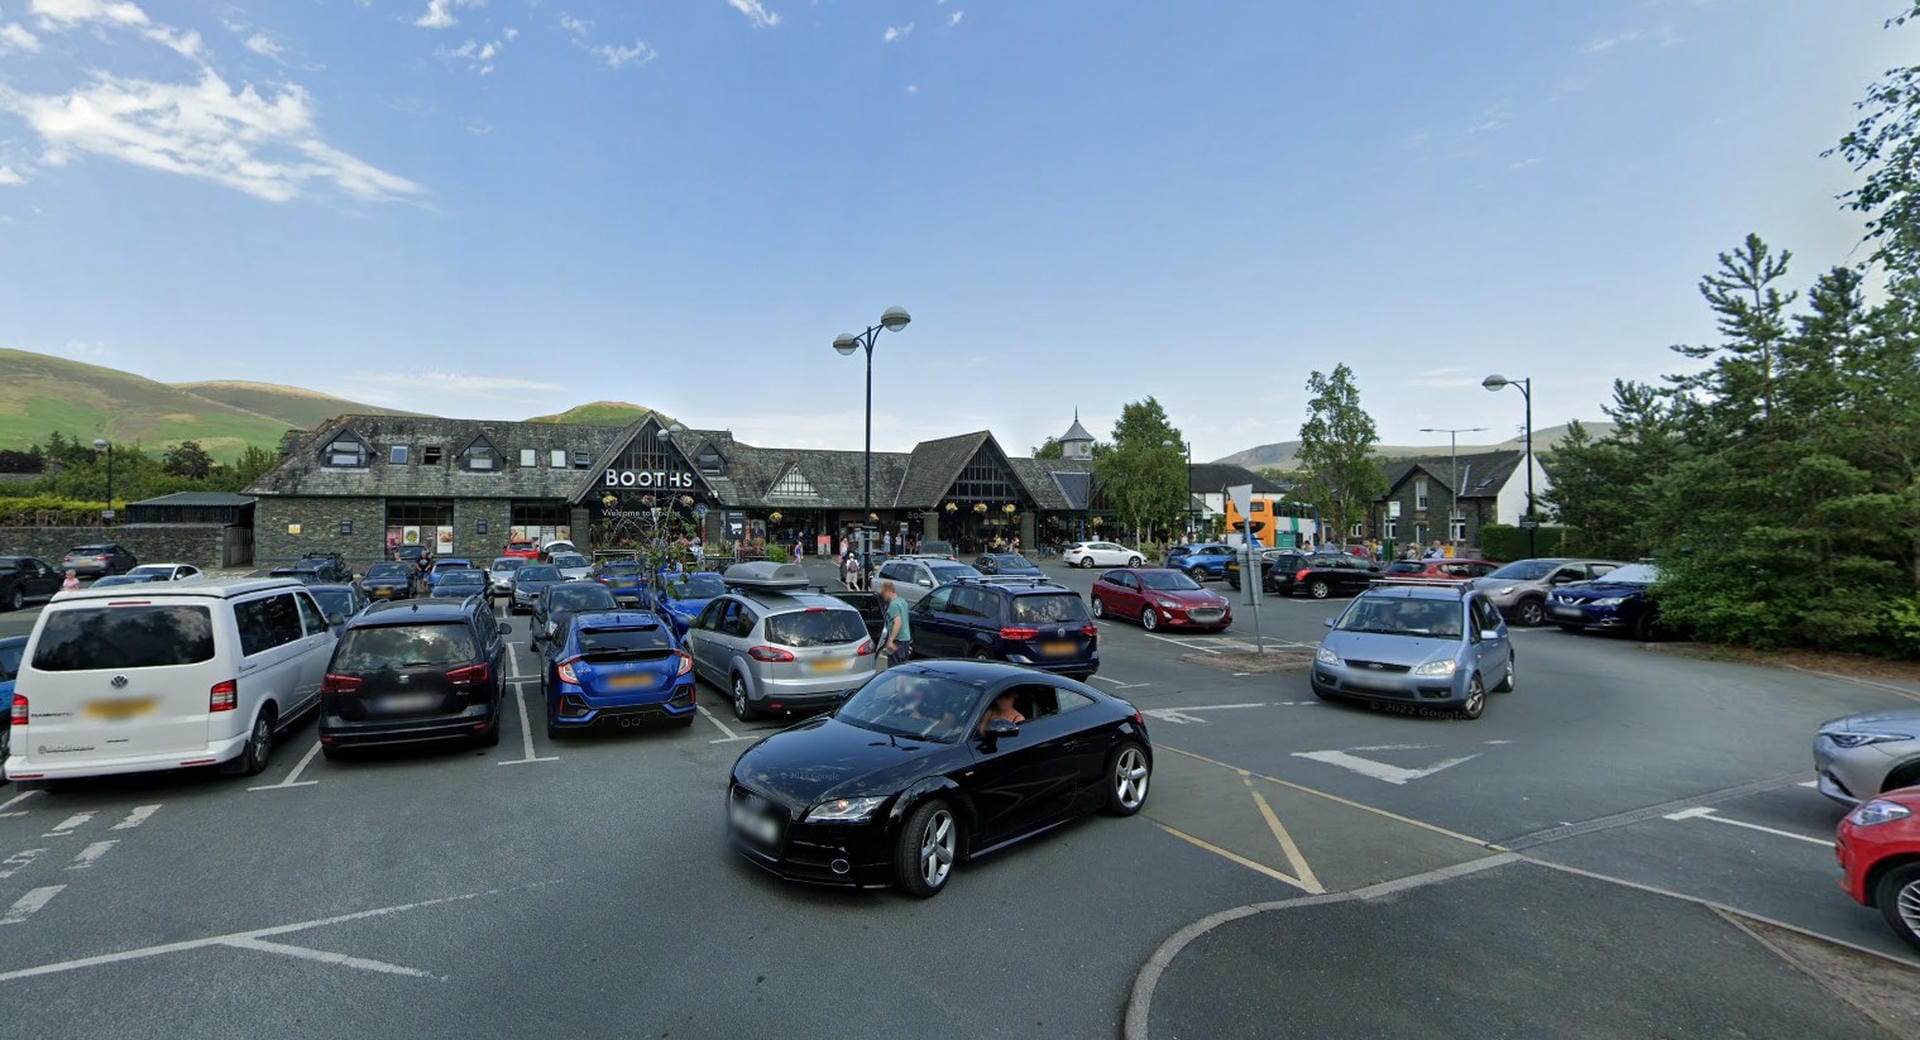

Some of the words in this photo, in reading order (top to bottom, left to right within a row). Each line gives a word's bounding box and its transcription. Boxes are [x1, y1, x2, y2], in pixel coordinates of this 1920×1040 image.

[605, 468, 693, 488] BOOTHS
[602, 508, 640, 518] Welcome
[642, 509, 651, 517] to
